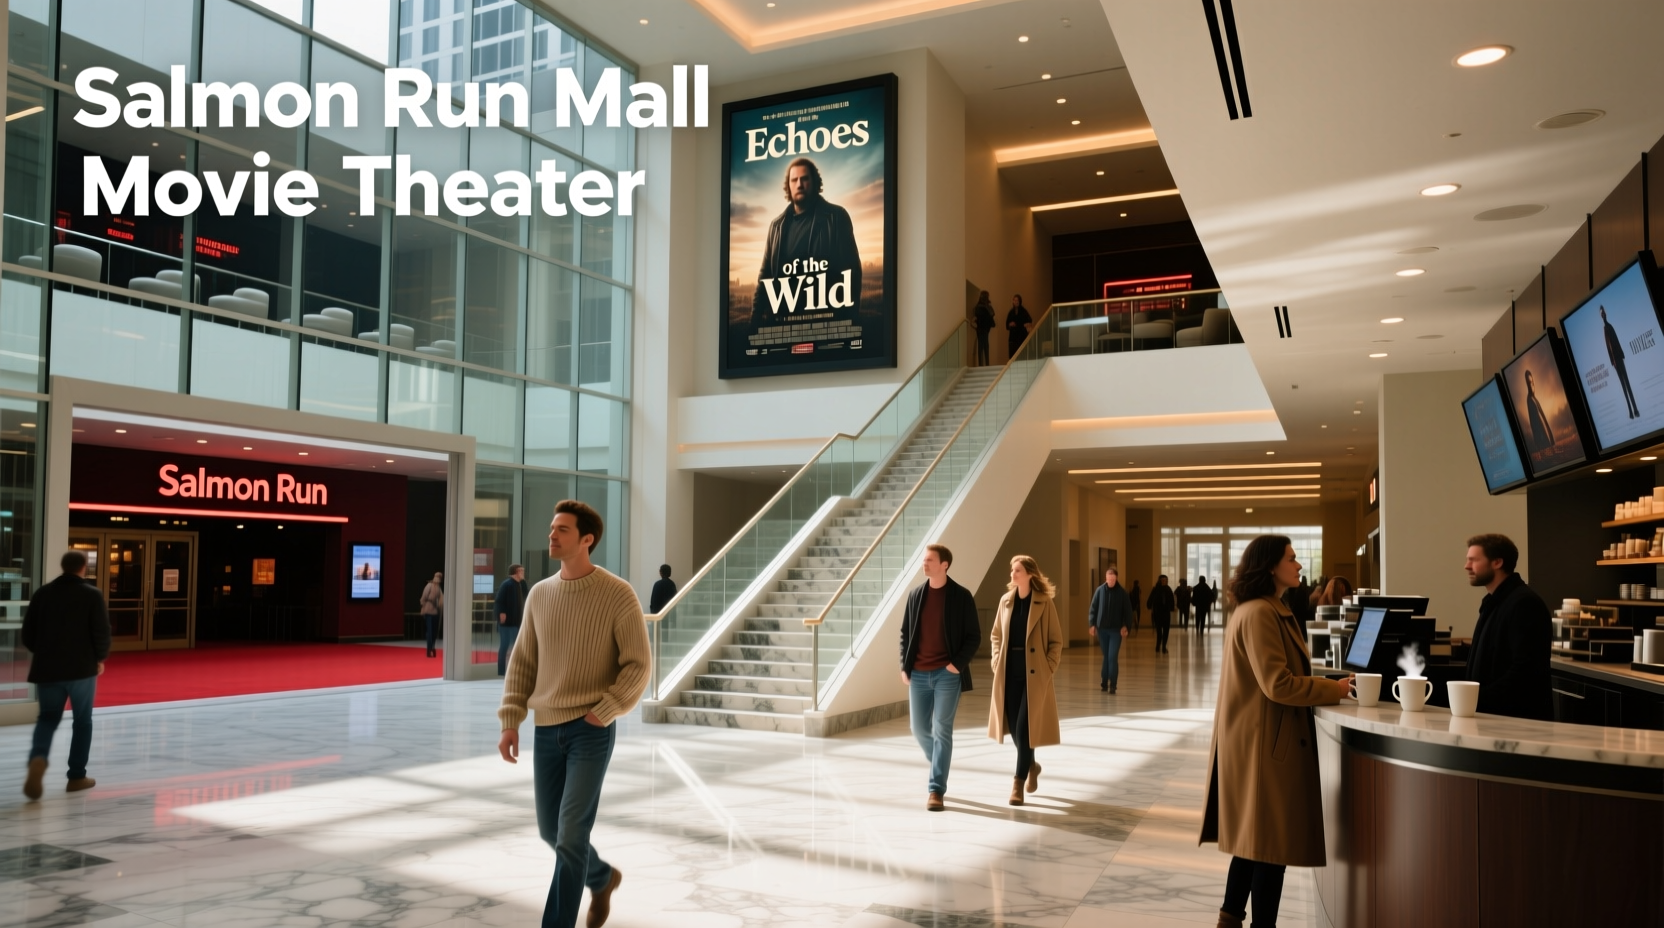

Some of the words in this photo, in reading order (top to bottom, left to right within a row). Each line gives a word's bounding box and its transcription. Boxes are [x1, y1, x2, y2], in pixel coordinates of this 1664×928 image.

[745, 120, 870, 163] Echoes
[782, 258, 800, 275] of
[803, 257, 829, 273] the
[761, 269, 855, 314] Wild
[159, 464, 270, 502] Salmon
[277, 474, 328, 505] Run
